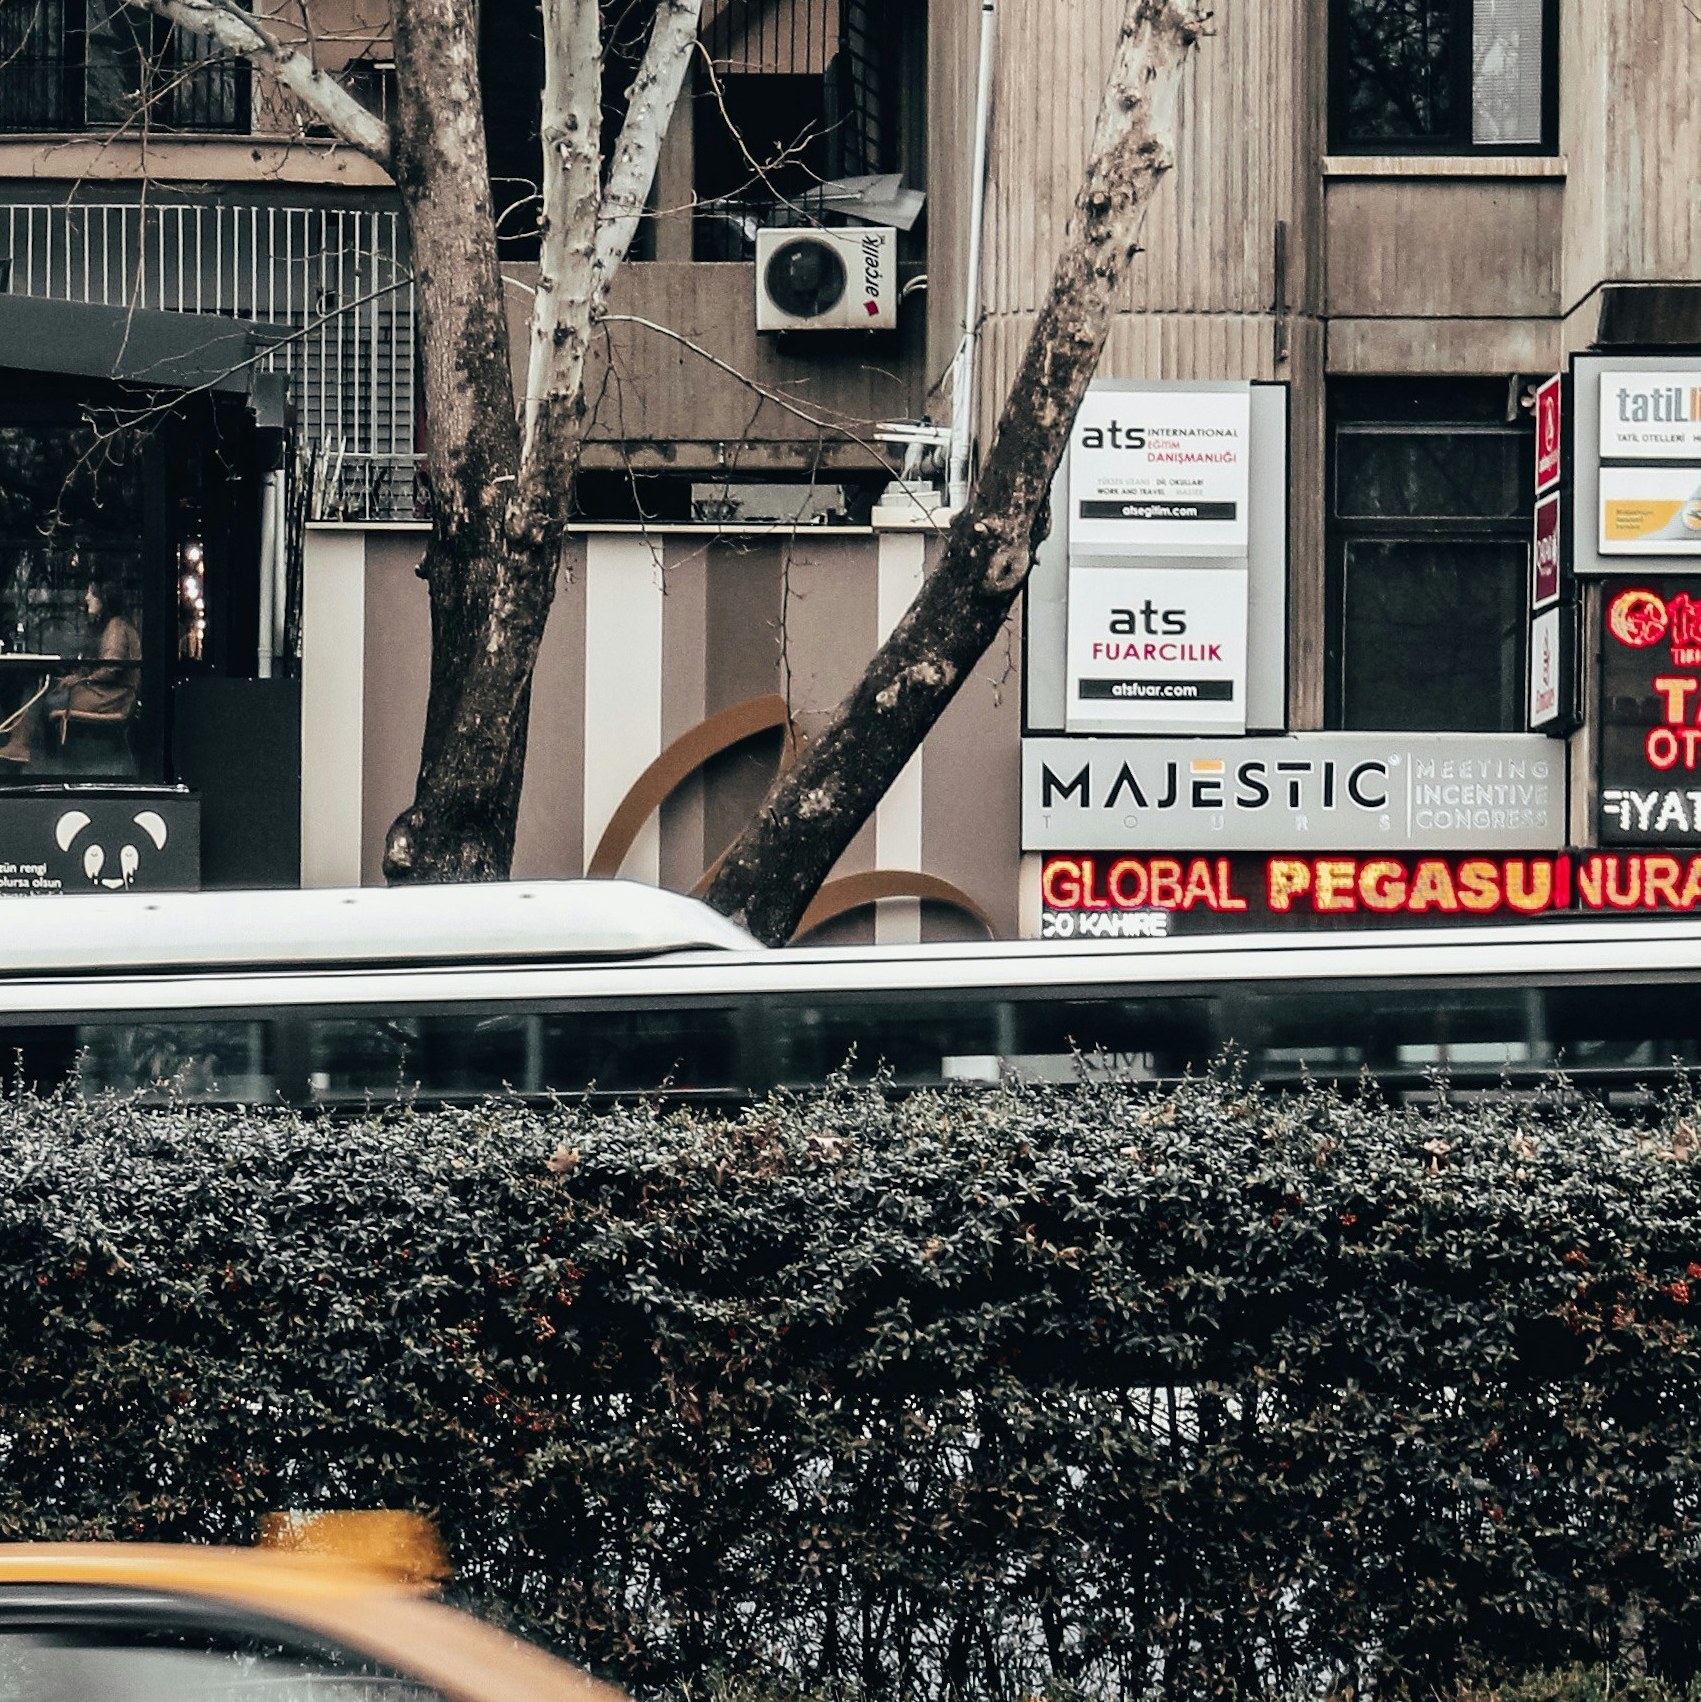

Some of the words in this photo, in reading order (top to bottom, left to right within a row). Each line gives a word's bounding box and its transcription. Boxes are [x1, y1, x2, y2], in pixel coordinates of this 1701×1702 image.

[862, 235, 883, 298] arçelik
[1082, 420, 1146, 449] ats
[1148, 428, 1238, 438] INTERNATIONAL
[1148, 439, 1181, 449] EĞİTİM
[1148, 451, 1237, 464] DANIŞMANLIĞI
[1109, 600, 1187, 635] ats
[1092, 642, 1223, 662] FUARCILIK
[1111, 682, 1198, 697] atsfuar.com
[1415, 759, 1548, 779] MEETING
[1042, 759, 1388, 809] MAJESTIC
[1415, 784, 1548, 806] INCENTIVE
[1415, 809, 1548, 829] CONGRESS
[20, 862, 47, 876] rengi
[32, 876, 62, 888] olsun
[1042, 857, 1248, 912] GLOBAL
[1268, 857, 1571, 915] PEGASU
